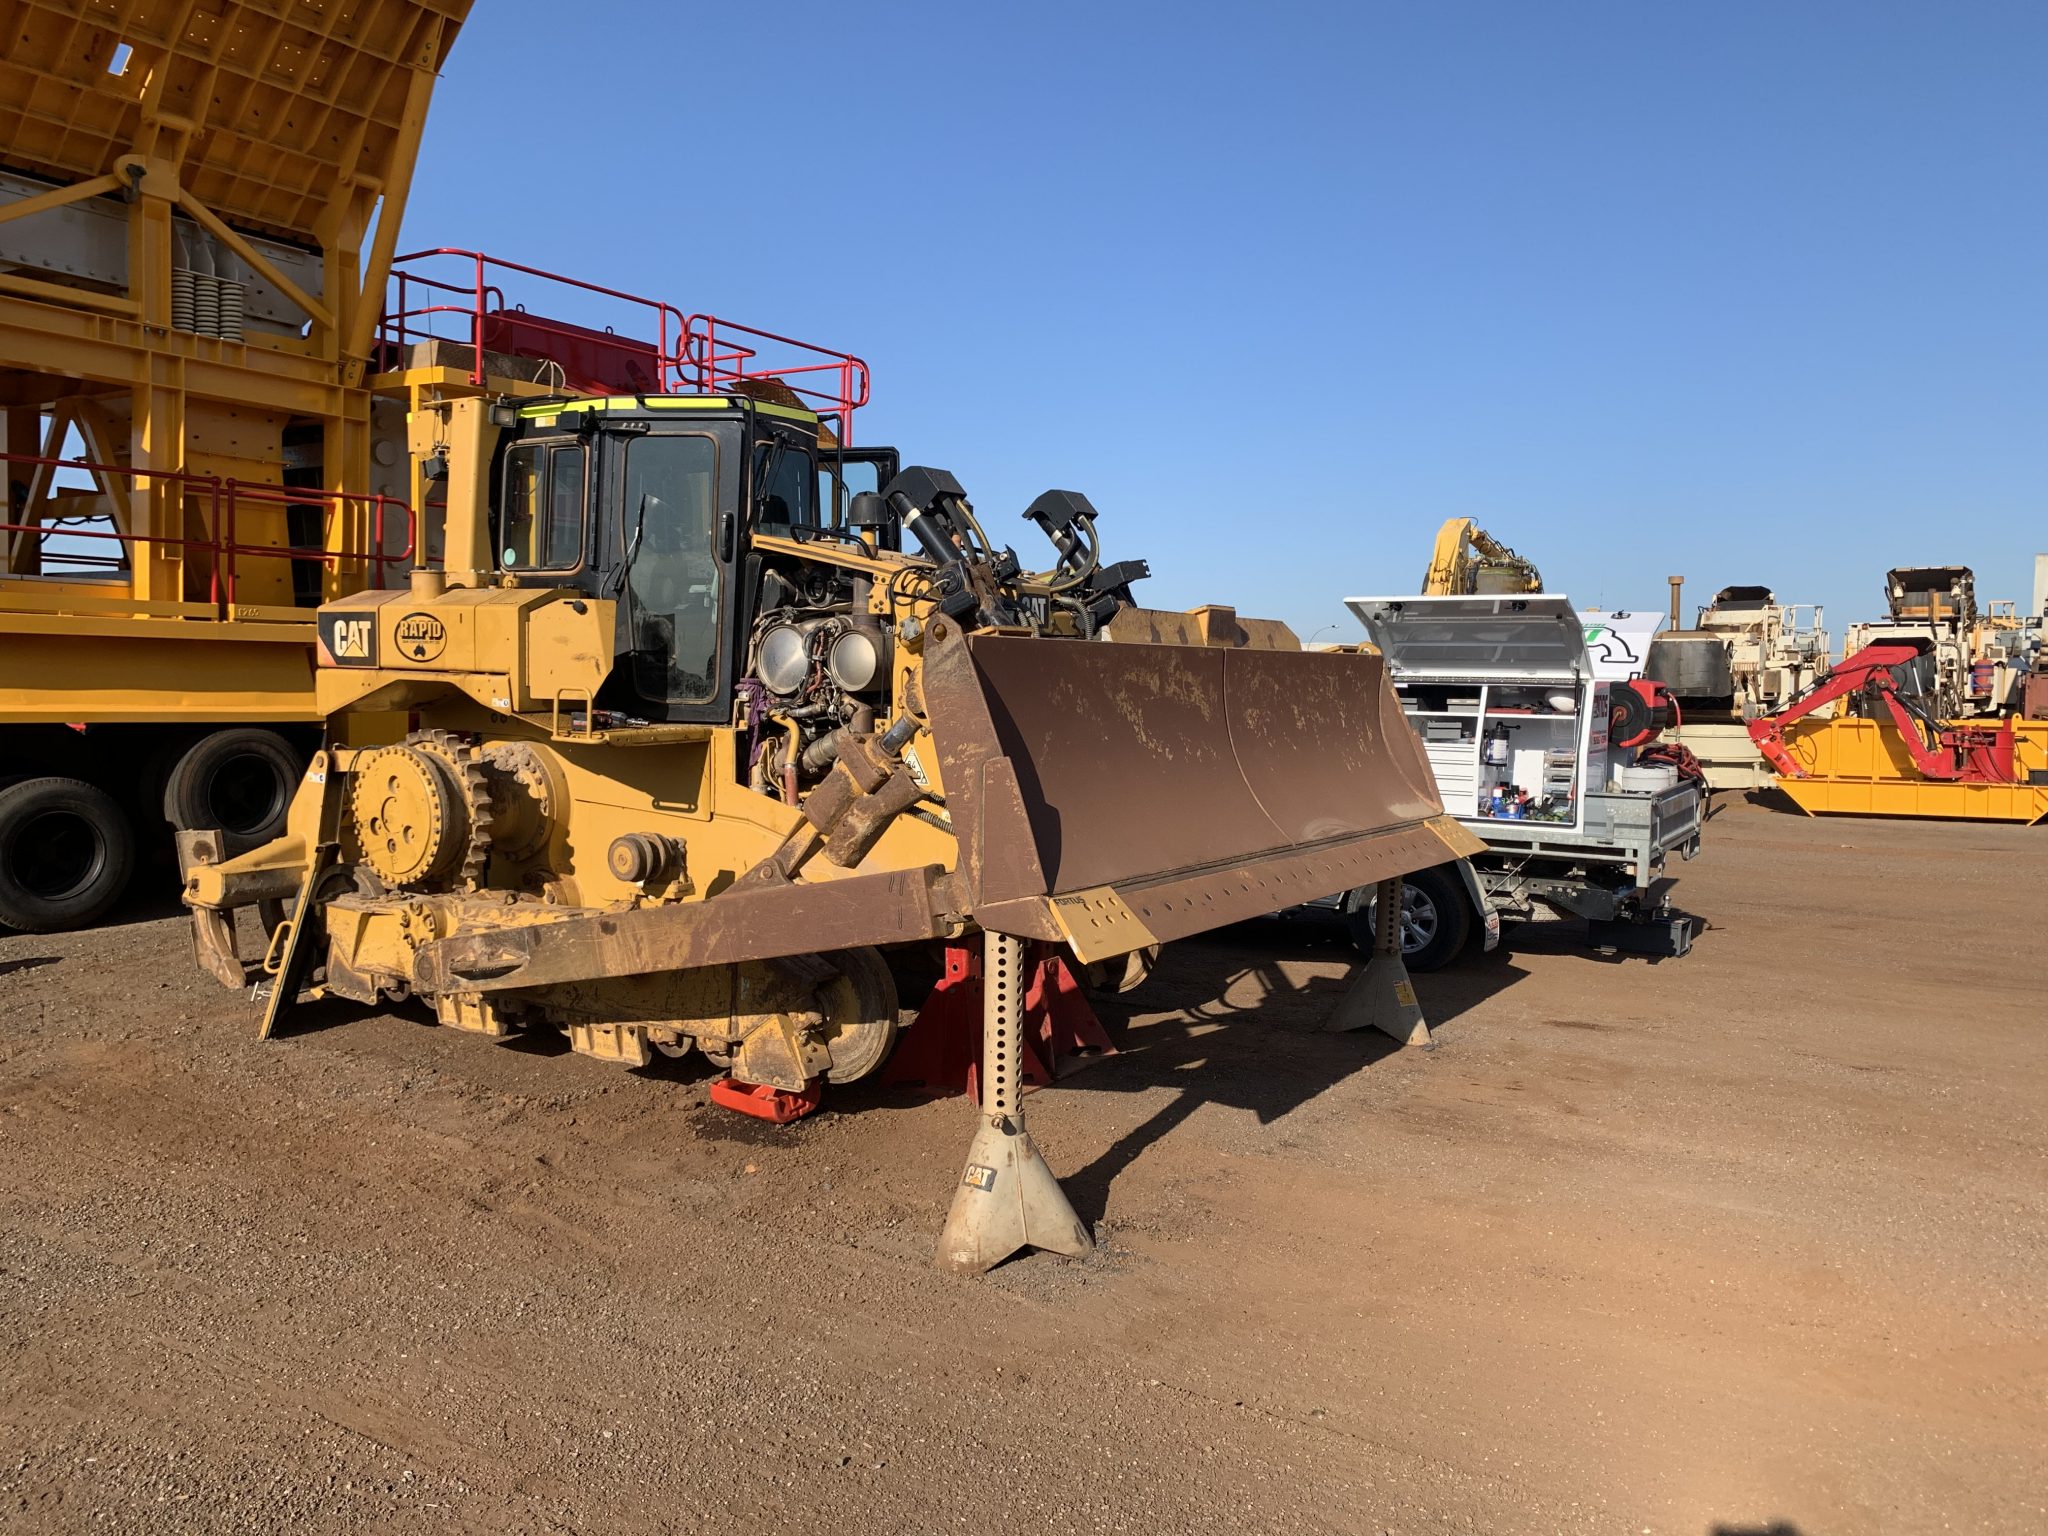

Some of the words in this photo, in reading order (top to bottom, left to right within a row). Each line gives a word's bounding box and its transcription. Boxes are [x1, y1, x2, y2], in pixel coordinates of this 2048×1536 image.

[334, 619, 371, 657] CAT
[400, 619, 443, 641] RAPID
[1054, 896, 1086, 907] FORTUS
[965, 1165, 993, 1187] CAT
